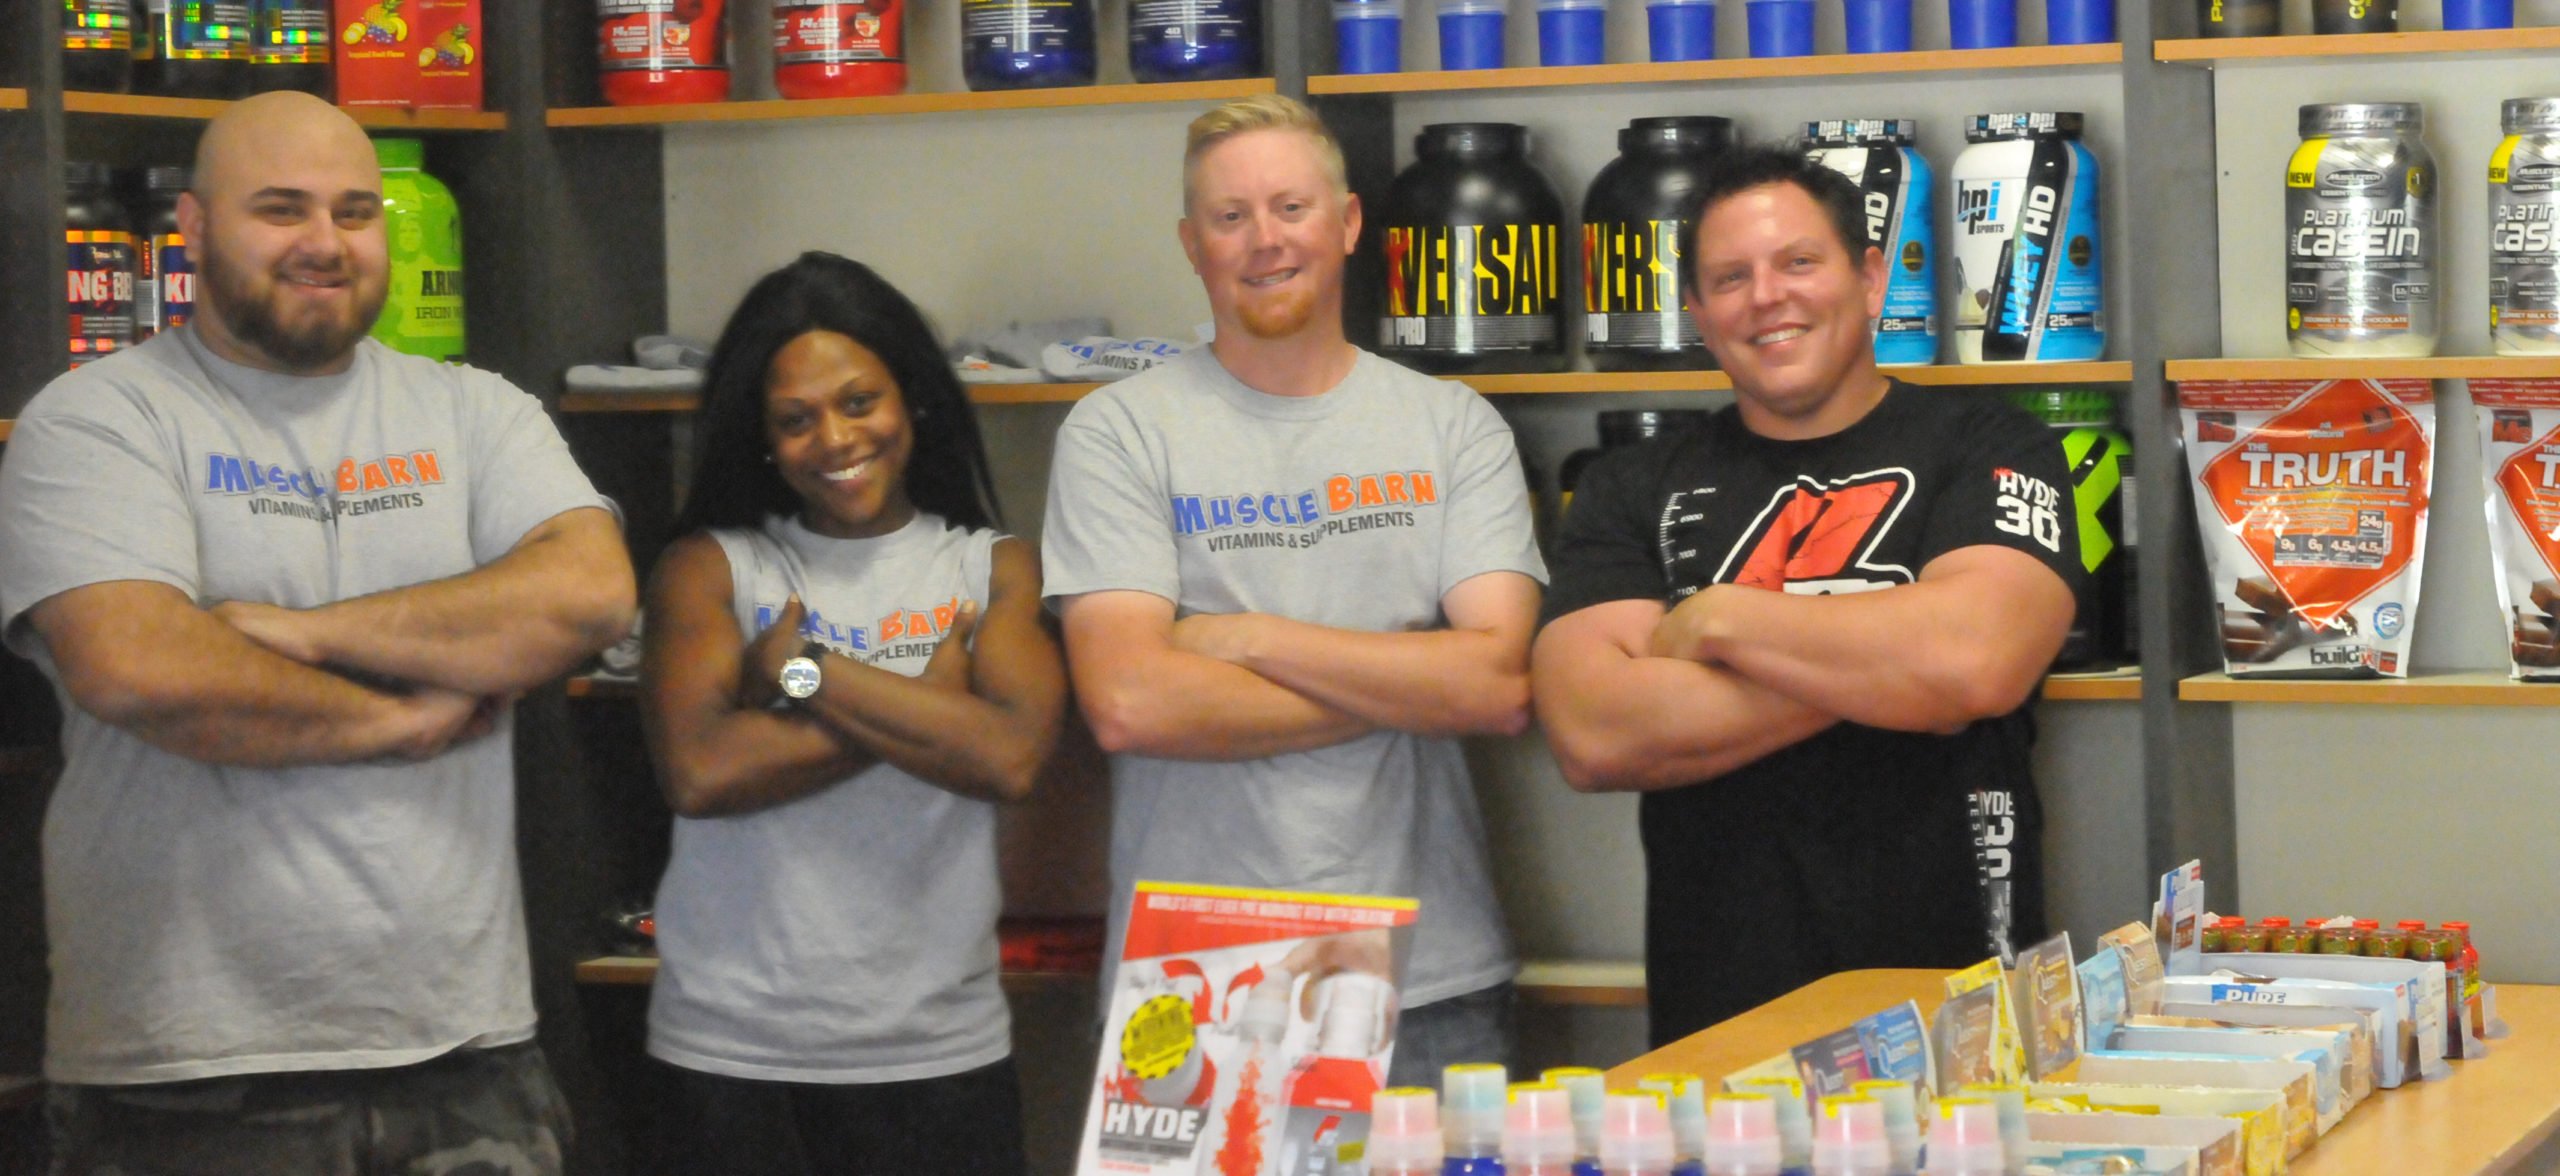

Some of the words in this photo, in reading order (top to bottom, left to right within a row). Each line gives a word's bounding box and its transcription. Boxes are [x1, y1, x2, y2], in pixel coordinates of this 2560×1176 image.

[2290, 172, 2312, 184] NEW
[1957, 180, 2001, 235] bpi
[2023, 185, 2056, 236] HD
[1976, 223, 2004, 234] SPORTS
[1998, 234, 2044, 334] WHEY
[416, 306, 450, 319] IRON
[2248, 442, 2269, 452] THE
[336, 452, 442, 493] BARN
[2241, 450, 2411, 488] T.R.U.T.H.
[1172, 493, 1319, 534] MUSCLE
[1327, 472, 1437, 513] BARN
[1999, 472, 2060, 517] HYDE
[1207, 532, 1285, 552] VITAMINS
[1287, 537, 1298, 549] &
[1300, 512, 1415, 549] SUPPLEMENTS
[1995, 494, 2061, 553] 30
[2281, 538, 2295, 551] 9g
[2308, 538, 2323, 552] 6g
[880, 597, 958, 643] BAR
[2310, 644, 2360, 665] build
[1968, 793, 1989, 886] RESULTS
[2225, 988, 2286, 1004] PURE
[1104, 1102, 1200, 1142] HYDE
